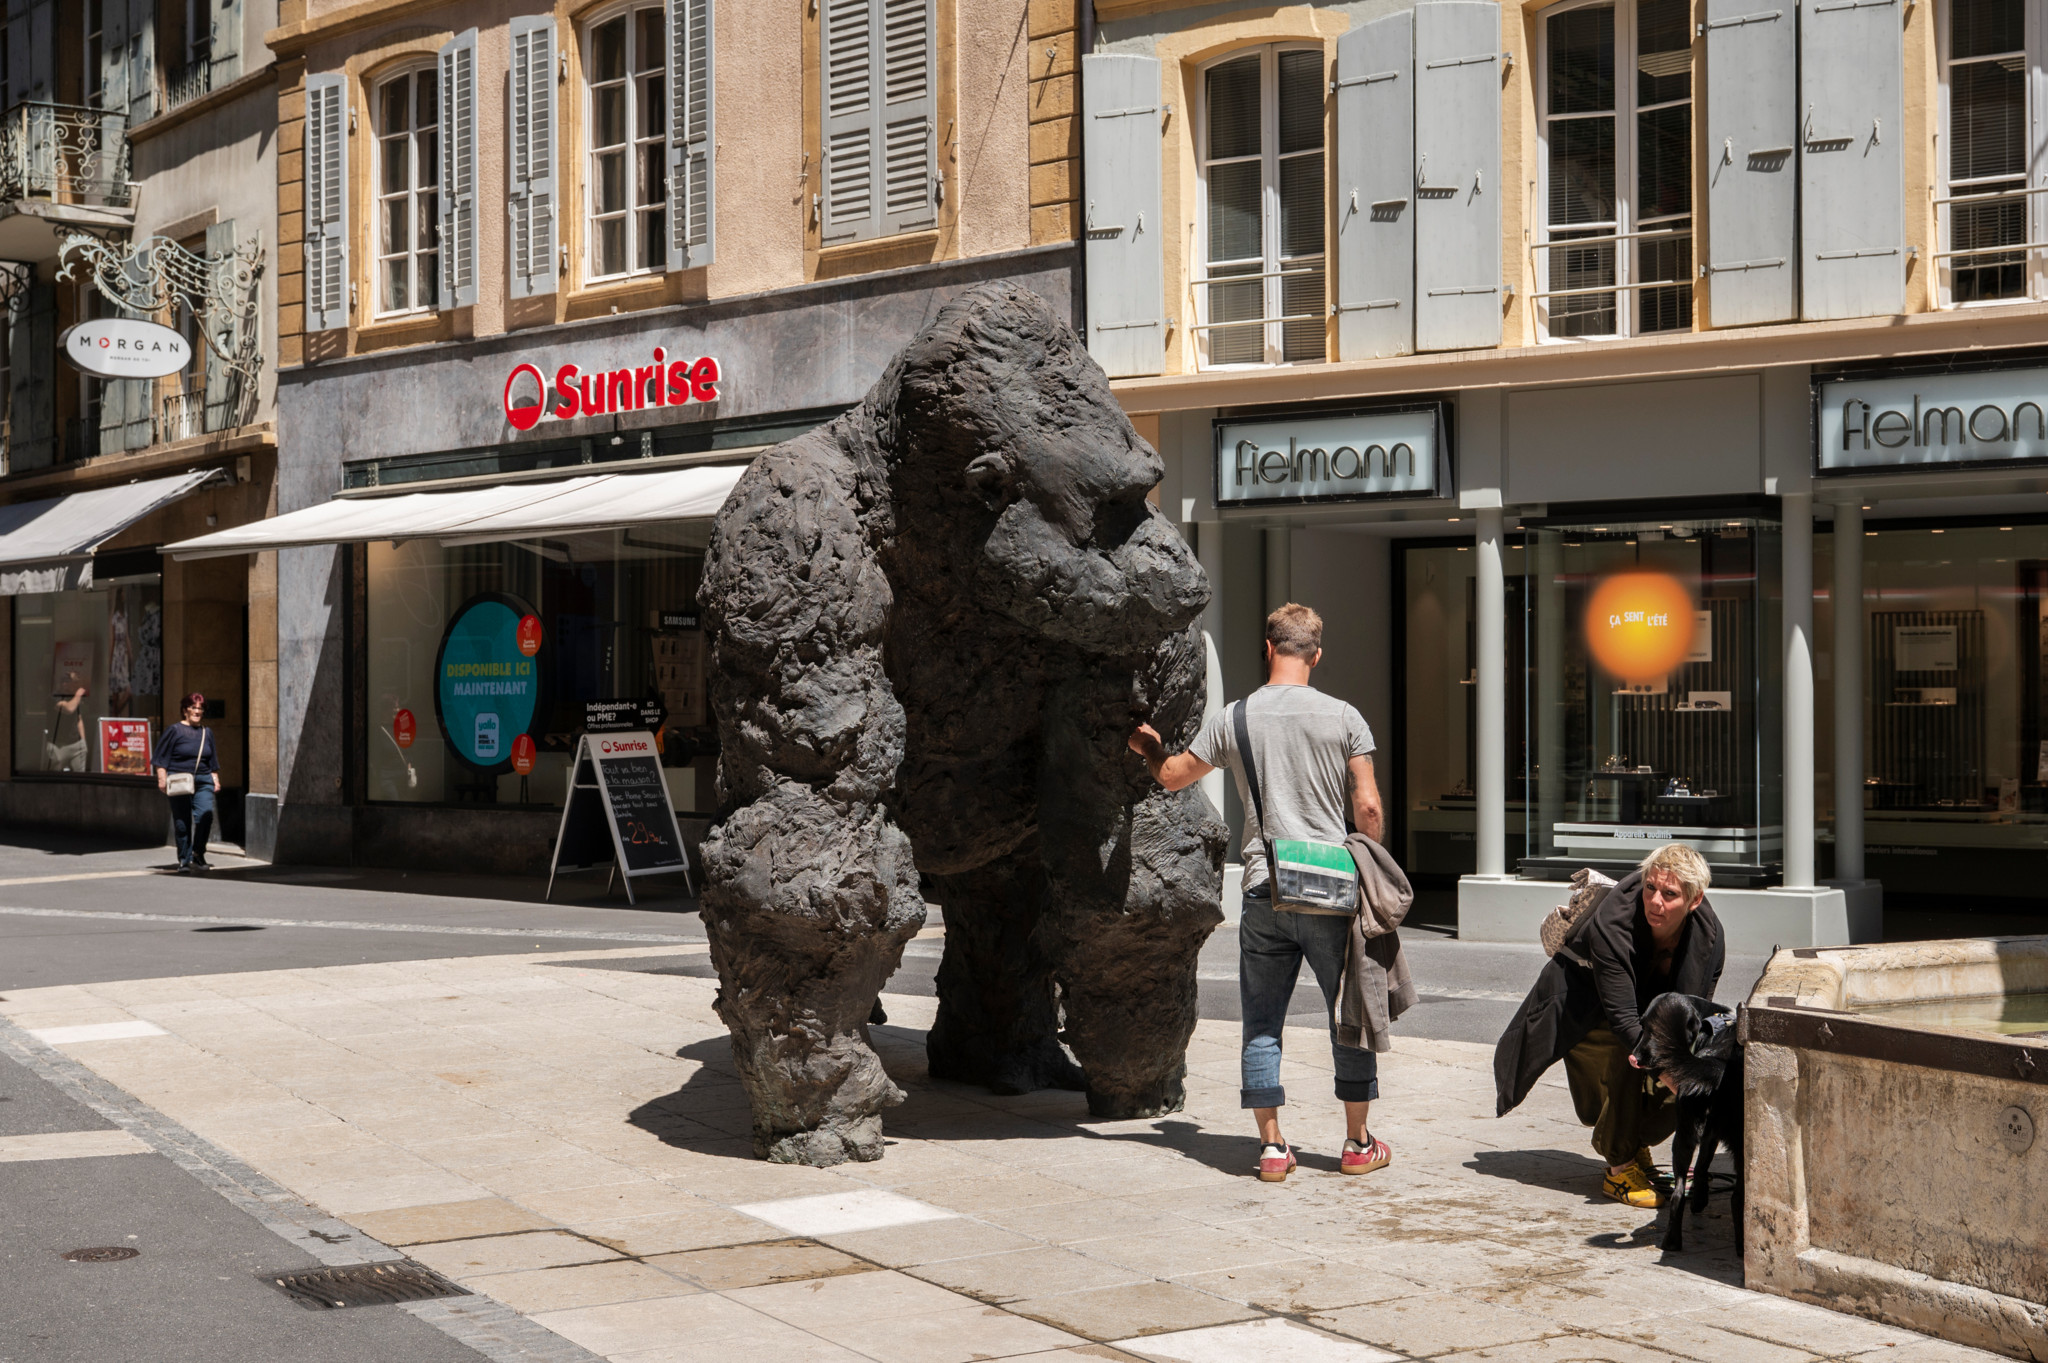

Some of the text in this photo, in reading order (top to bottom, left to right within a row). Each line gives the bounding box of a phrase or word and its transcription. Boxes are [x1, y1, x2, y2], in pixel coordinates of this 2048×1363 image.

[80, 336, 179, 352] MORGAN
[554, 347, 721, 419] Sunrise
[664, 616, 696, 626] SAMSUNG
[1609, 615, 1621, 628] ÇA
[1624, 611, 1644, 622] SENT
[447, 662, 530, 677] DISPONIBLE ICI
[454, 681, 527, 696] MAINTENANT
[596, 712, 617, 722] PME?
[478, 718, 496, 731] yallo
[613, 740, 648, 752] Sunrise
[1613, 829, 1672, 839] Appareils auditifs
